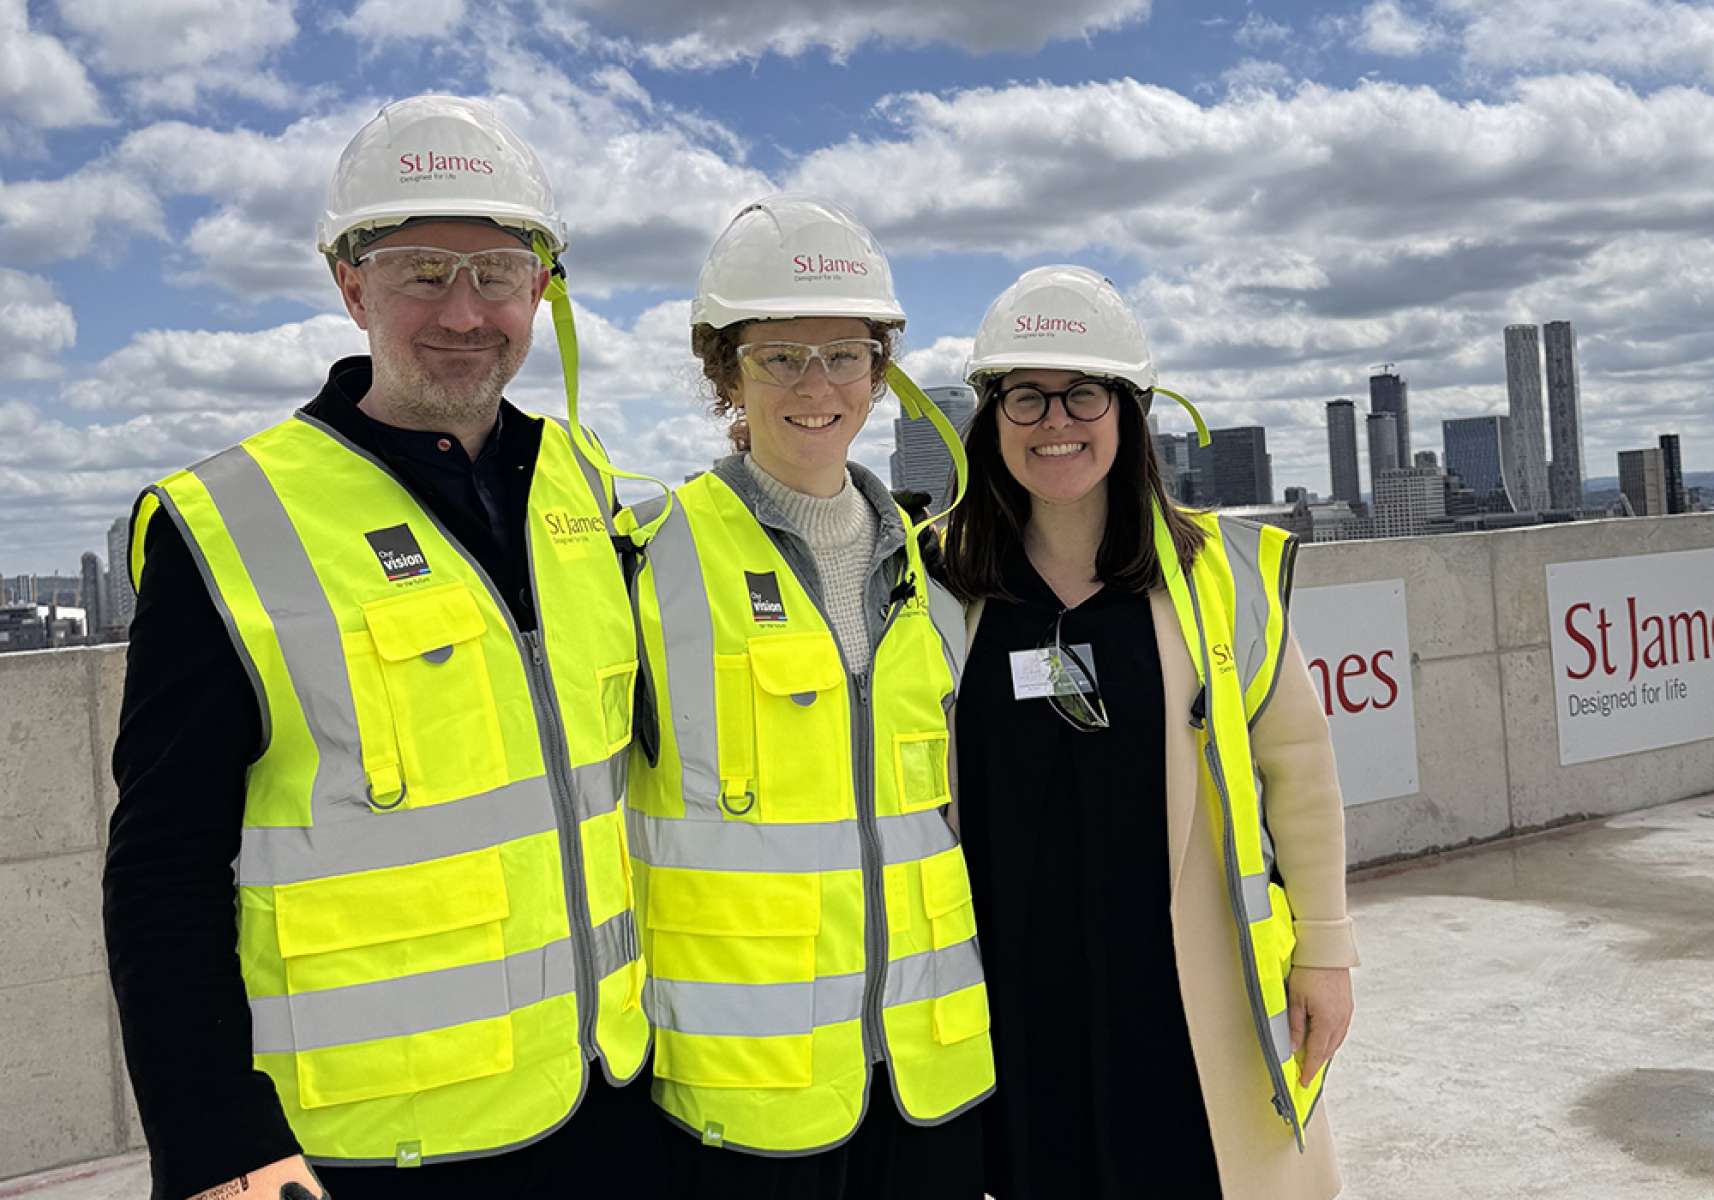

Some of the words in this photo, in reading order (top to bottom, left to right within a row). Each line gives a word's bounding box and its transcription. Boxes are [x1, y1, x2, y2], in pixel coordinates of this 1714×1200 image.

[400, 153, 423, 174] St
[428, 151, 493, 174] James
[793, 254, 816, 273] St
[818, 254, 868, 276] James
[1015, 315, 1032, 332] St
[1035, 314, 1087, 334] James
[545, 512, 565, 535] St
[563, 512, 606, 535] James
[383, 553, 424, 570] vision
[753, 600, 783, 612] vision
[1564, 602, 1617, 680] St
[1627, 597, 1714, 682] Jam
[1569, 686, 1637, 717] Designed
[1641, 683, 1661, 704] for
[1665, 678, 1688, 700] life
